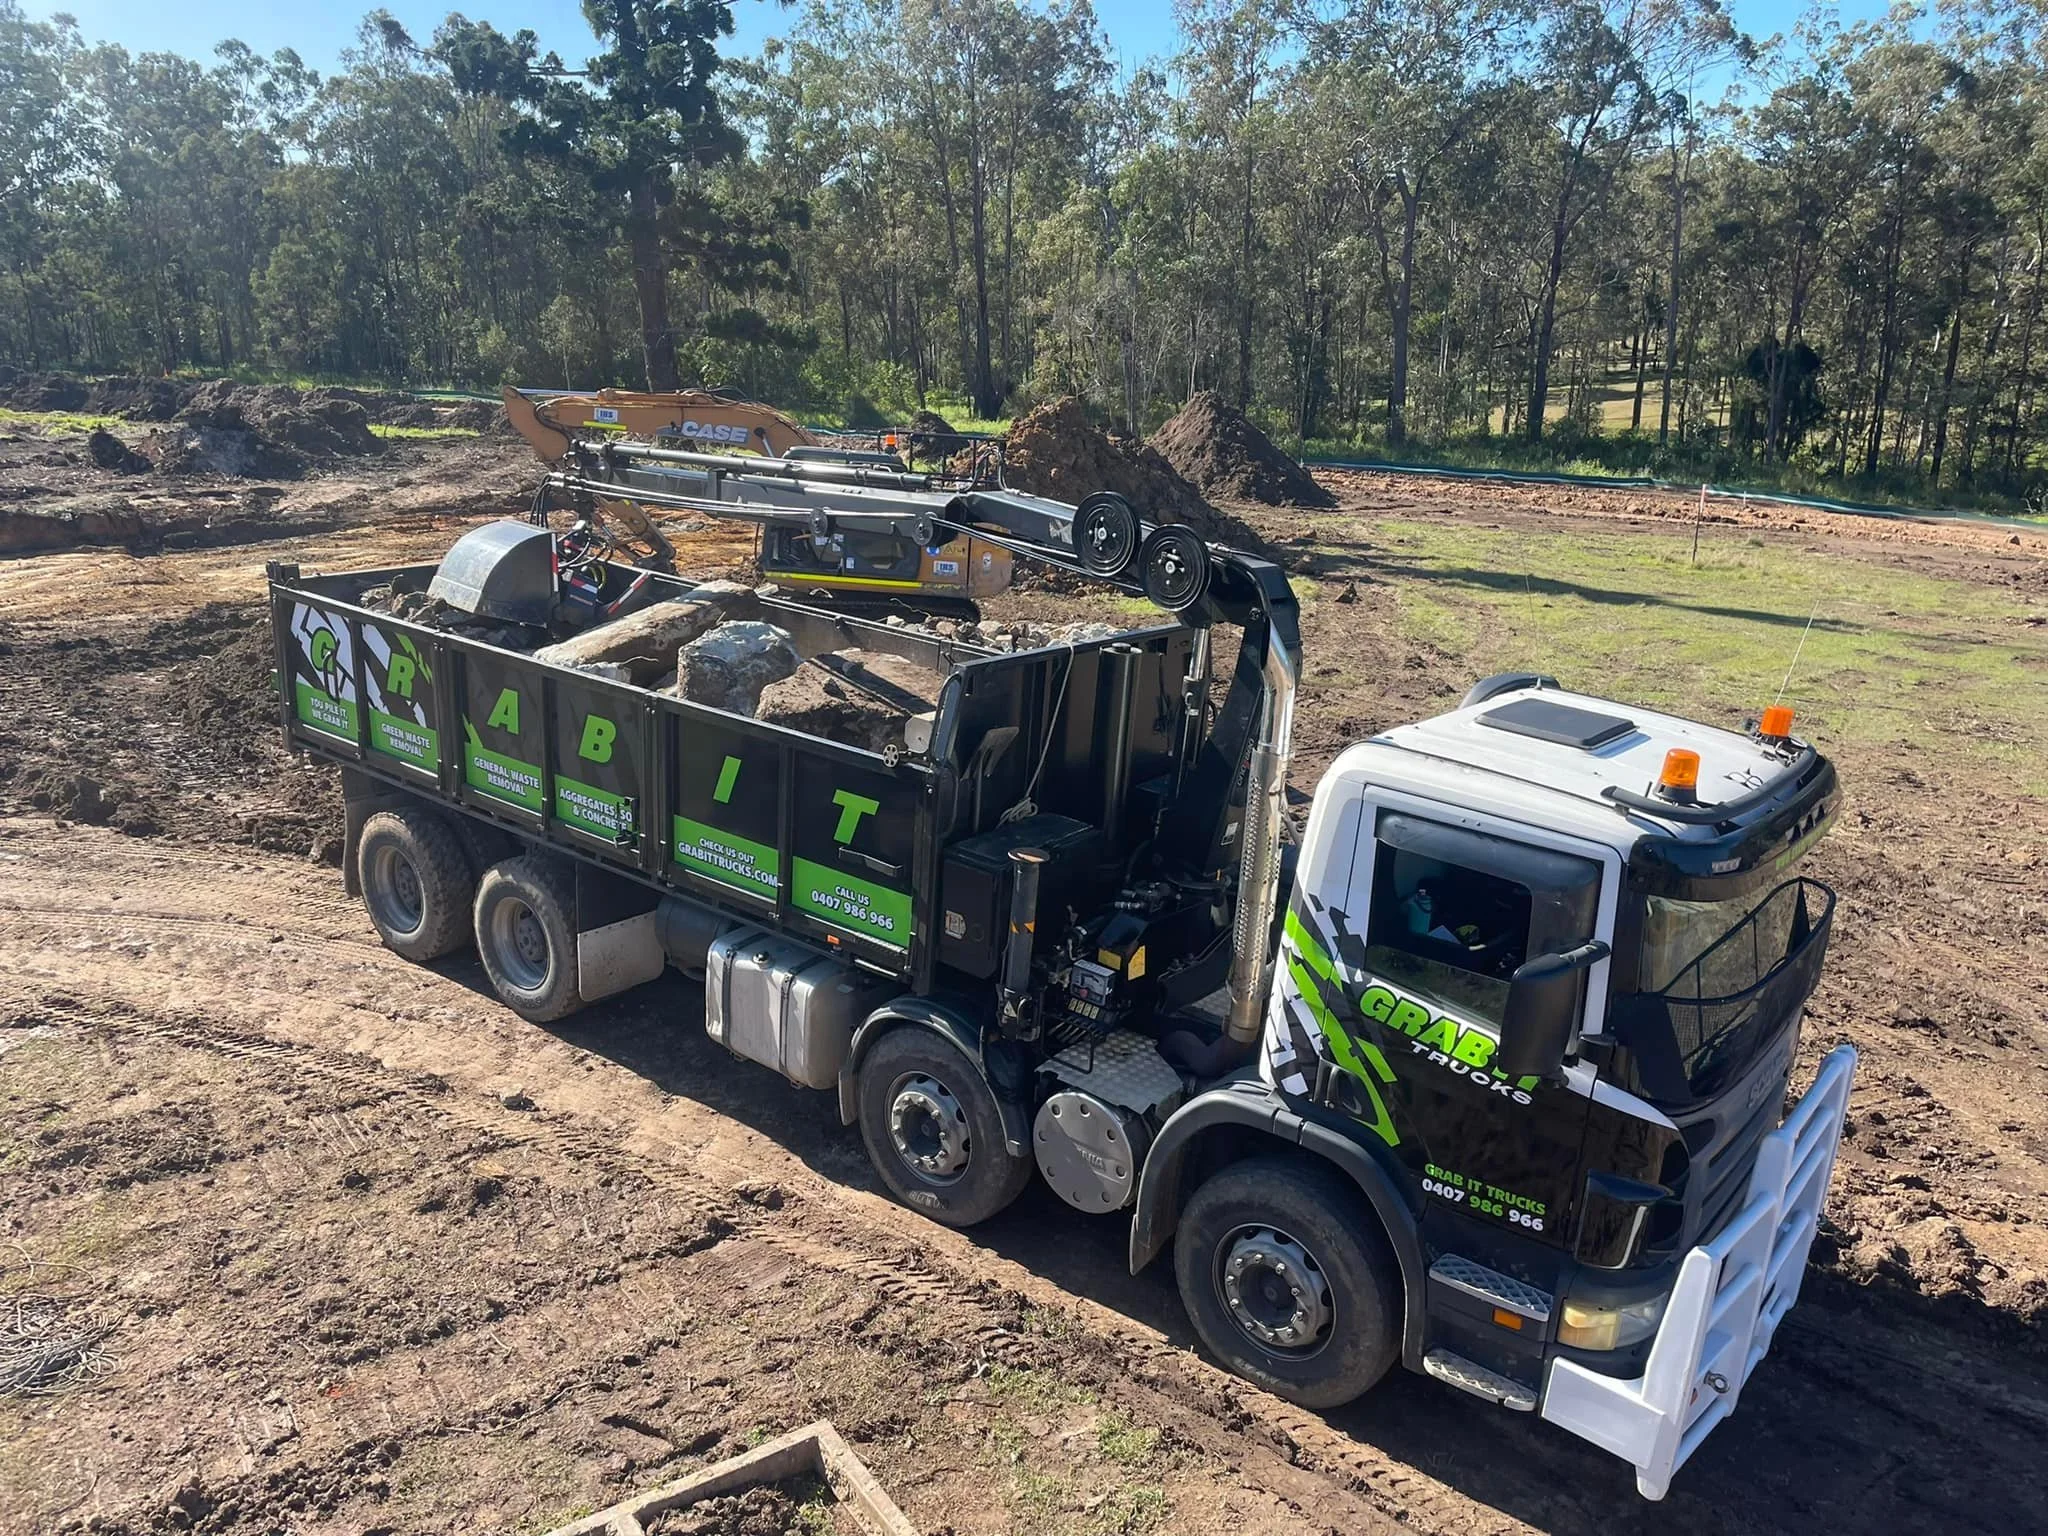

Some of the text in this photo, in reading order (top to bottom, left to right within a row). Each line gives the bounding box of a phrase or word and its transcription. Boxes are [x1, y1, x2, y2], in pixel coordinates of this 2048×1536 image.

[681, 421, 748, 442] CASE
[312, 709, 322, 720] WE
[381, 723, 431, 749] GREEN WASTE
[390, 737, 424, 757] REMOVAL
[473, 756, 539, 789] GENERAL WASTE
[487, 774, 526, 797] REMOVAL
[678, 841, 778, 889] GRABITTRUCKS.COM
[699, 836, 755, 865] CHECK US OUT
[811, 889, 894, 931] 0407 986 966
[835, 884, 870, 906] CALL US
[1359, 986, 1541, 1092] GRAB
[1410, 1040, 1533, 1106] TRUCKS
[1422, 1177, 1544, 1232] 0407 986 966
[1424, 1162, 1546, 1216] GRAB IT TRUCKS
